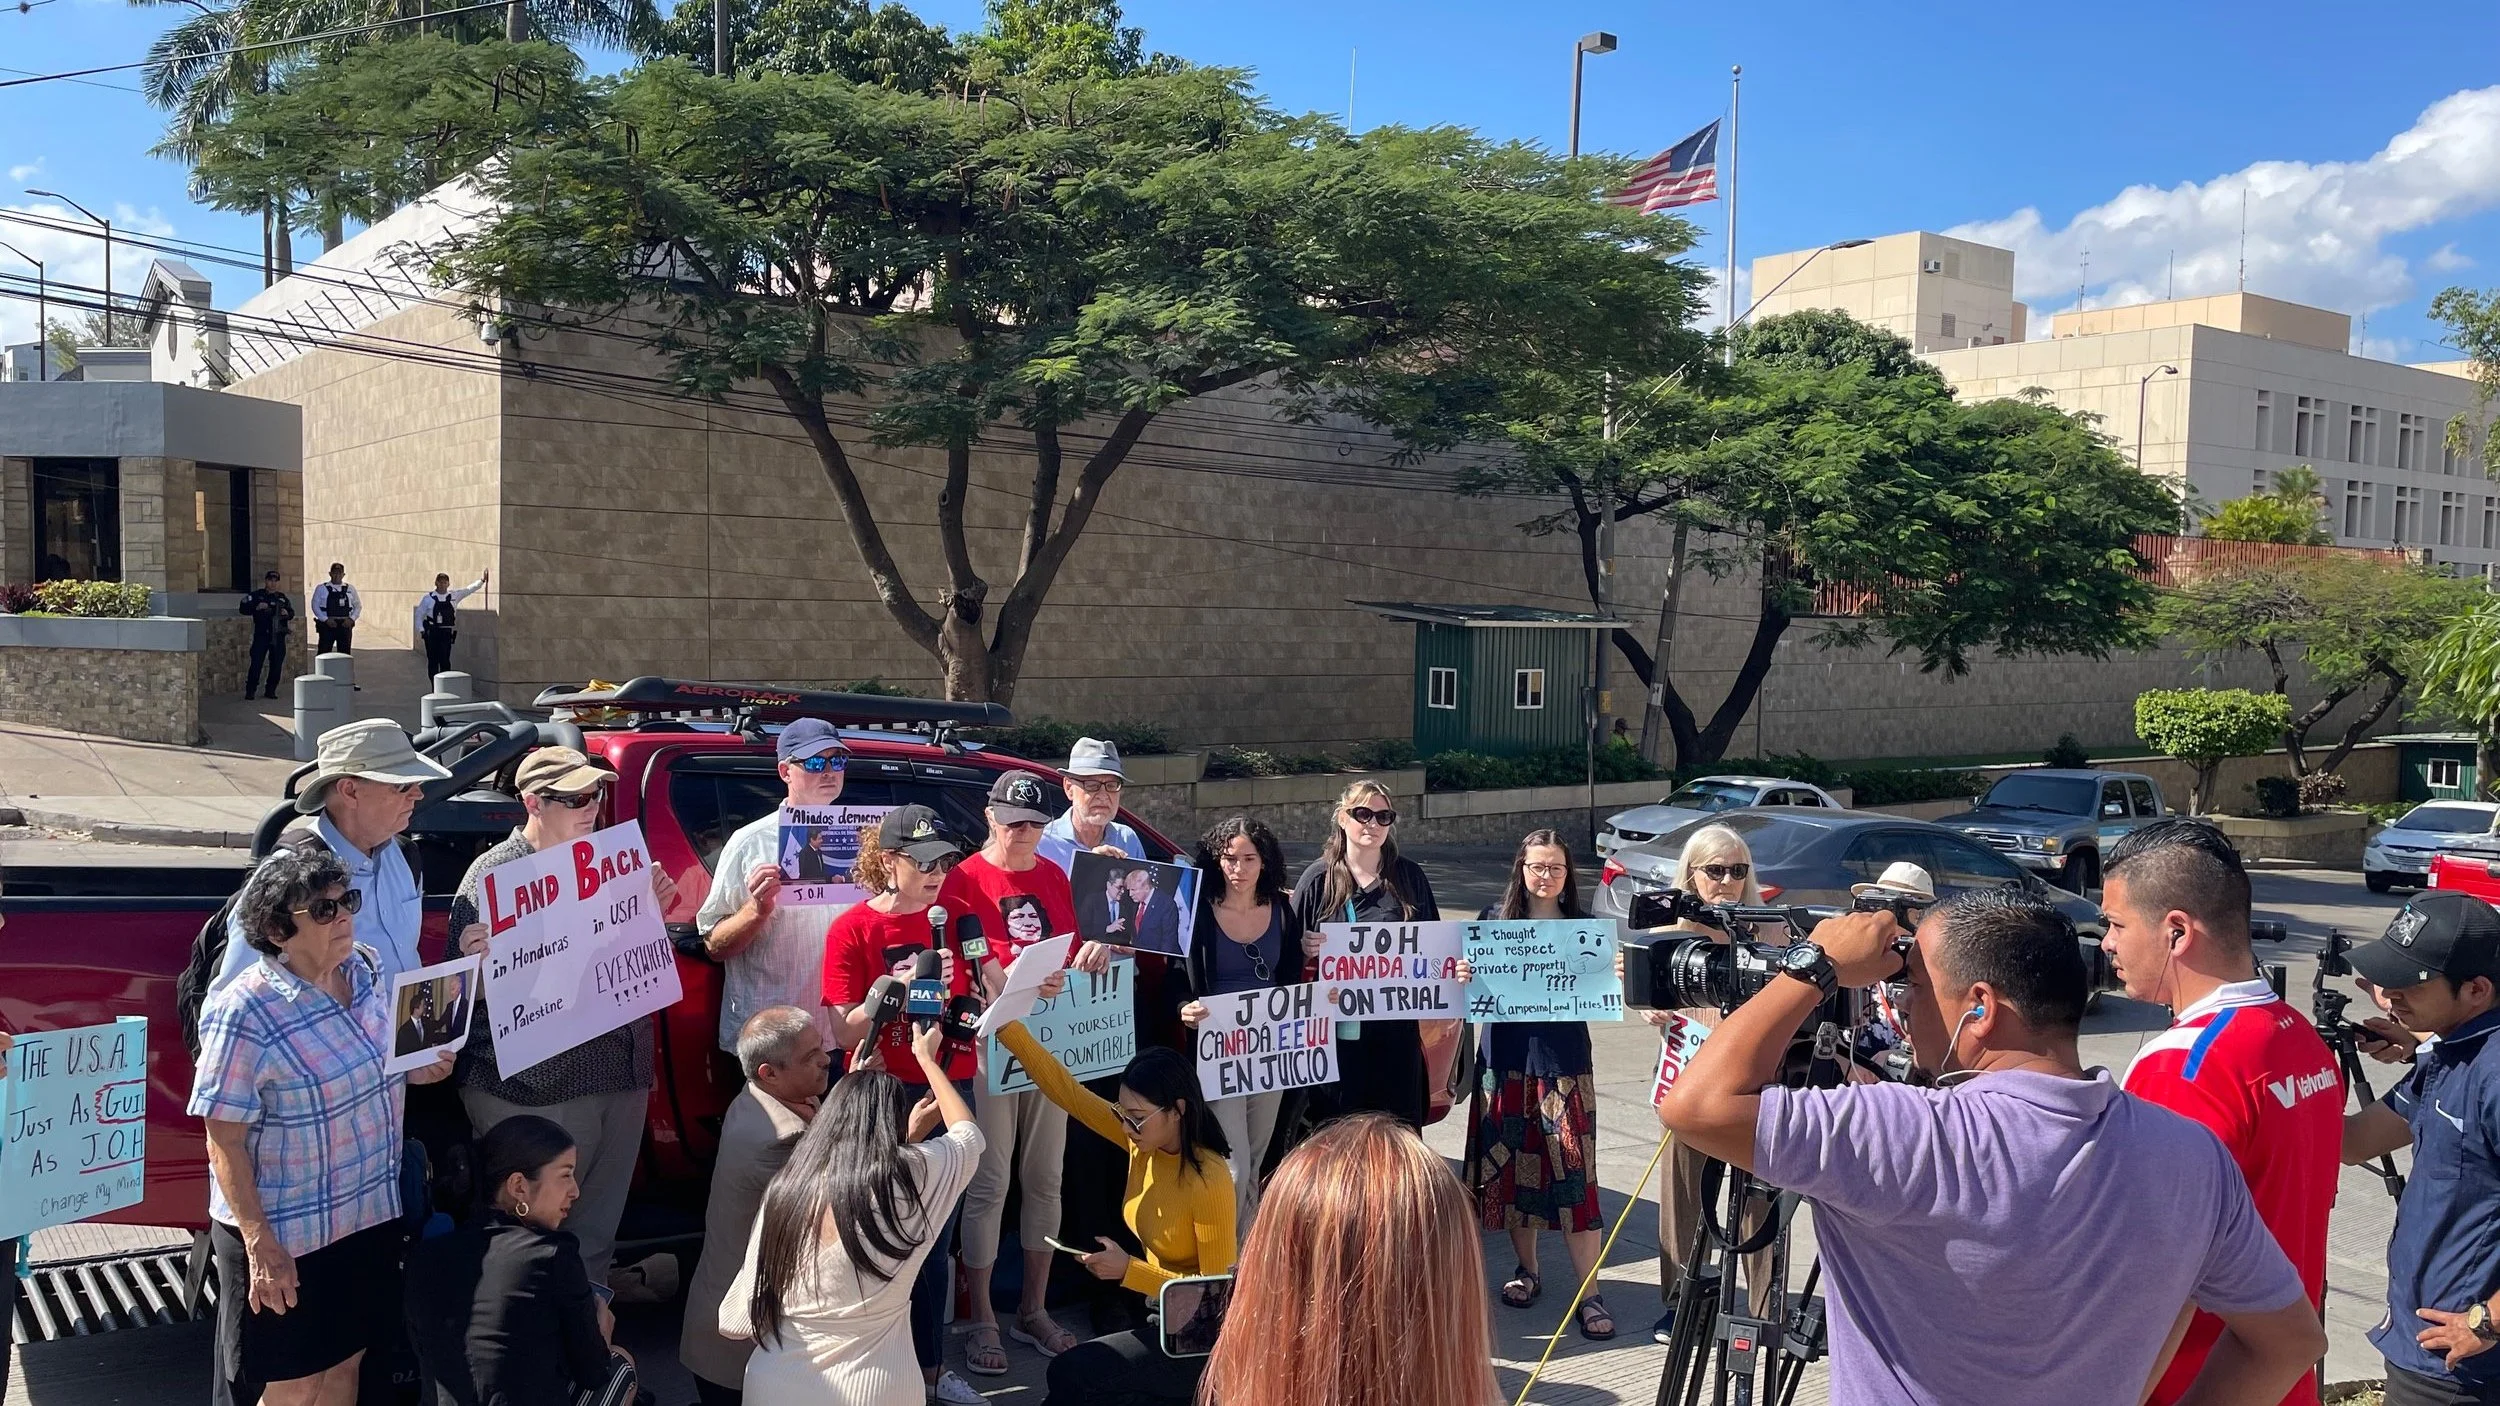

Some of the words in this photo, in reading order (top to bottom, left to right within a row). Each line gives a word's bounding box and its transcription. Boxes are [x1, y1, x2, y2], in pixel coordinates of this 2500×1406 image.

[674, 684, 801, 703] AERORACK
[741, 697, 790, 706] LIGHT
[838, 806, 891, 825] democra
[484, 873, 559, 937] LAND
[572, 841, 643, 900] BACK
[593, 918, 605, 935] in
[1467, 926, 1481, 941] I
[1491, 926, 1537, 943] thought
[492, 959, 507, 980] in
[511, 936, 570, 970] Honduras
[595, 937, 673, 994] EVERYWHERE
[1467, 947, 1495, 963] you
[1505, 943, 1556, 957] respect
[1469, 963, 1518, 983] private
[1523, 960, 1566, 981] property
[1338, 988, 1375, 1016] ON
[1380, 985, 1449, 1011] TRIAL
[498, 1023, 510, 1040] in
[513, 998, 564, 1031] Palestine
[1068, 1009, 1133, 1036] YOURSELF
[13, 1039, 53, 1083] THE
[1000, 1031, 1135, 1085] AOUNTABLE
[1219, 1058, 1253, 1096] EN
[1259, 1046, 1329, 1090] JUICIO
[40, 1189, 89, 1217] Change
[95, 1184, 111, 1206] My
[116, 1173, 141, 1192] Mind
